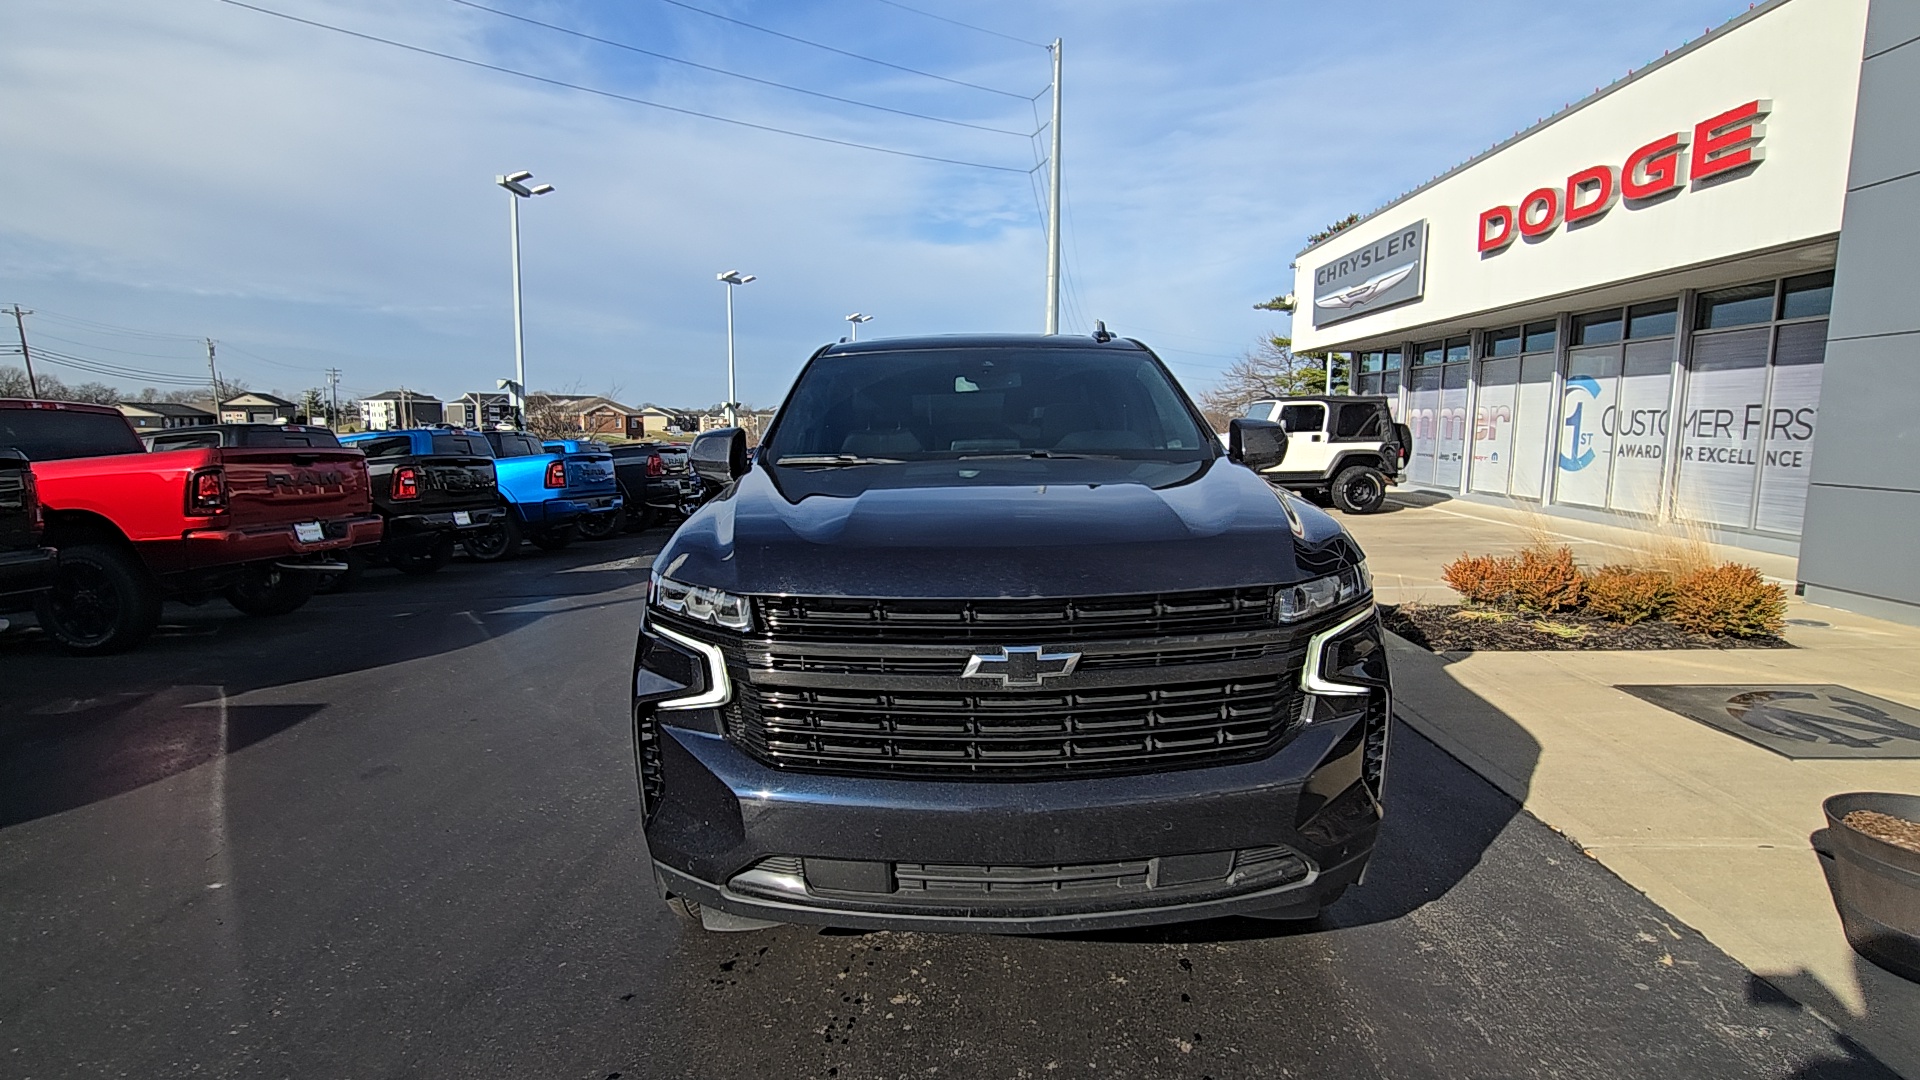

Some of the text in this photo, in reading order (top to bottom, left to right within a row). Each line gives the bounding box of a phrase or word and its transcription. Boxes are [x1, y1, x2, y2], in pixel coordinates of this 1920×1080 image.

[1478, 99, 1771, 252] DODGE
[1317, 230, 1416, 285] CHRYSLER
[1742, 404, 1817, 441] FIRS
[1617, 443, 1662, 459] AWARD
[1698, 446, 1804, 468] EXCELLNCE
[265, 471, 344, 488] RAM
